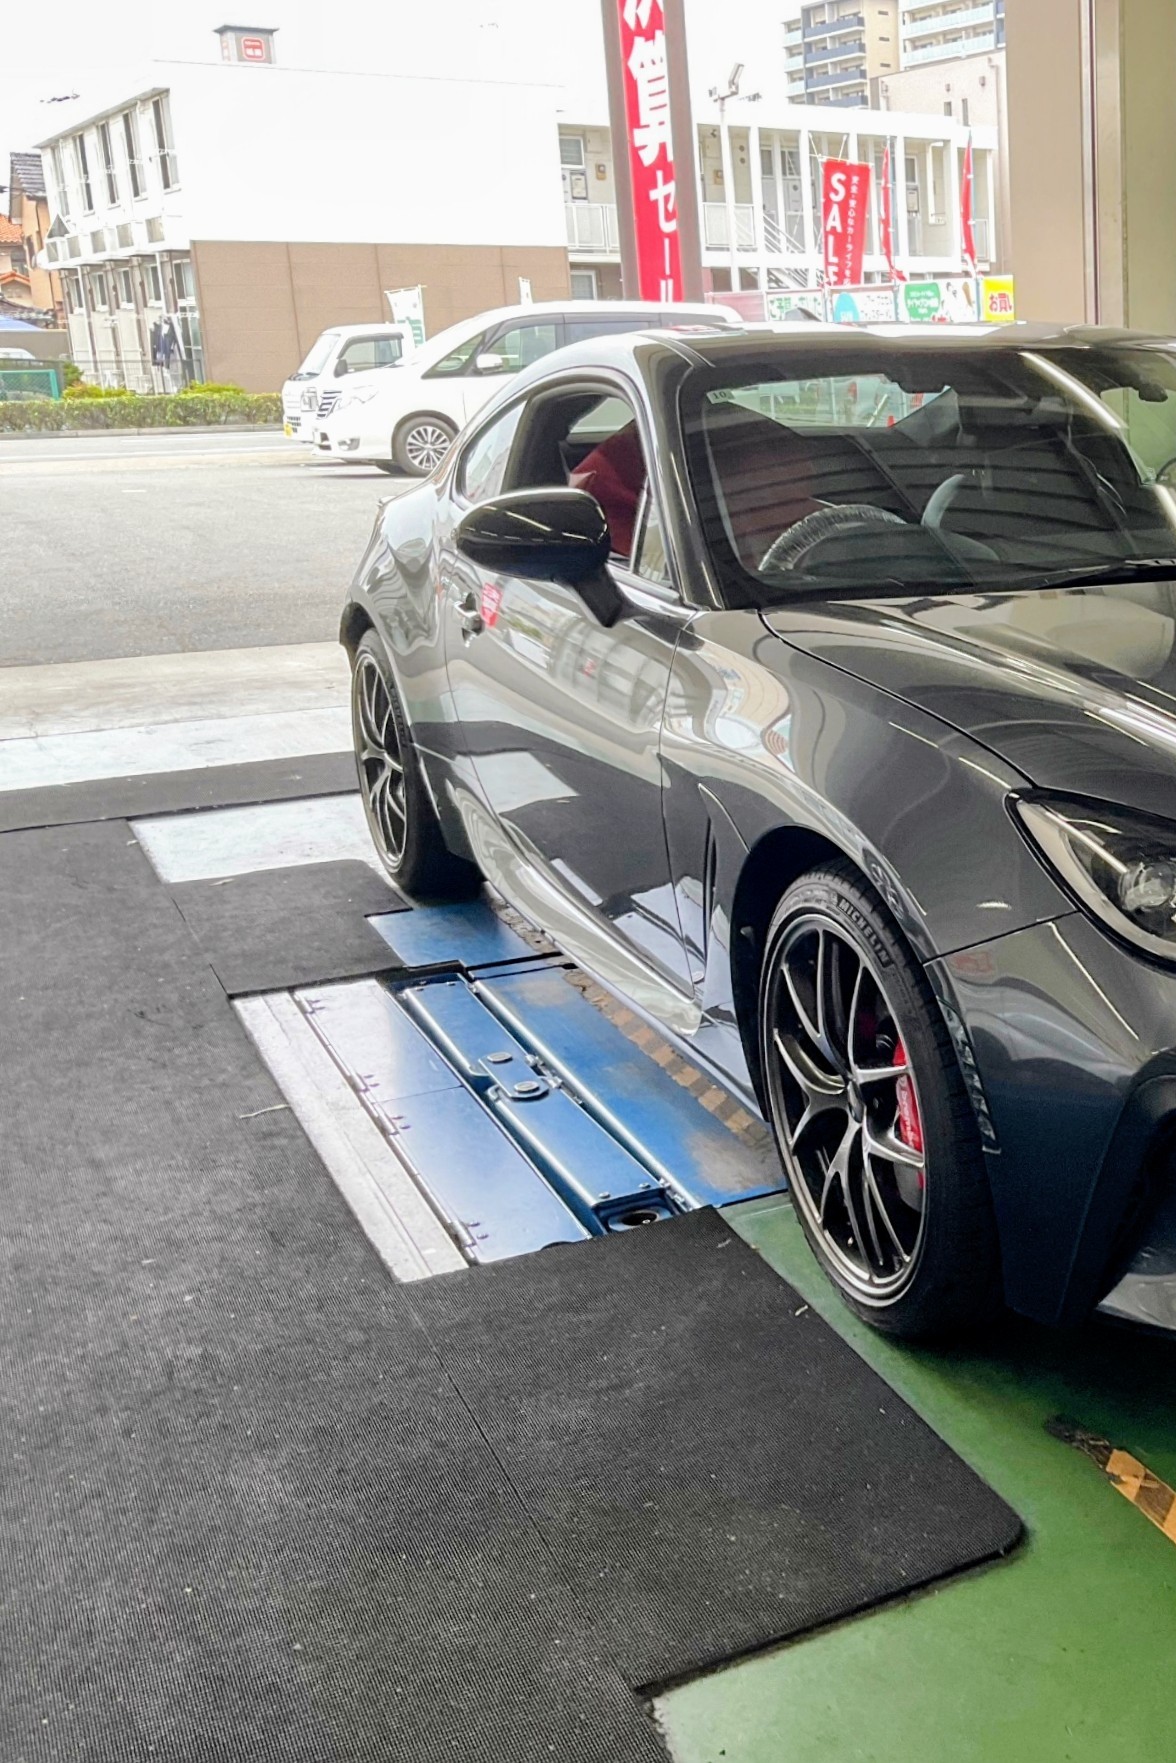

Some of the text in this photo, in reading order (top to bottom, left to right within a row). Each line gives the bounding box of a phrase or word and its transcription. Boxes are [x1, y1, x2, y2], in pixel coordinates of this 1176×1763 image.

[825, 172, 847, 286] SALE
[712, 391, 727, 400] 10
[837, 898, 890, 963] MICHELIN
